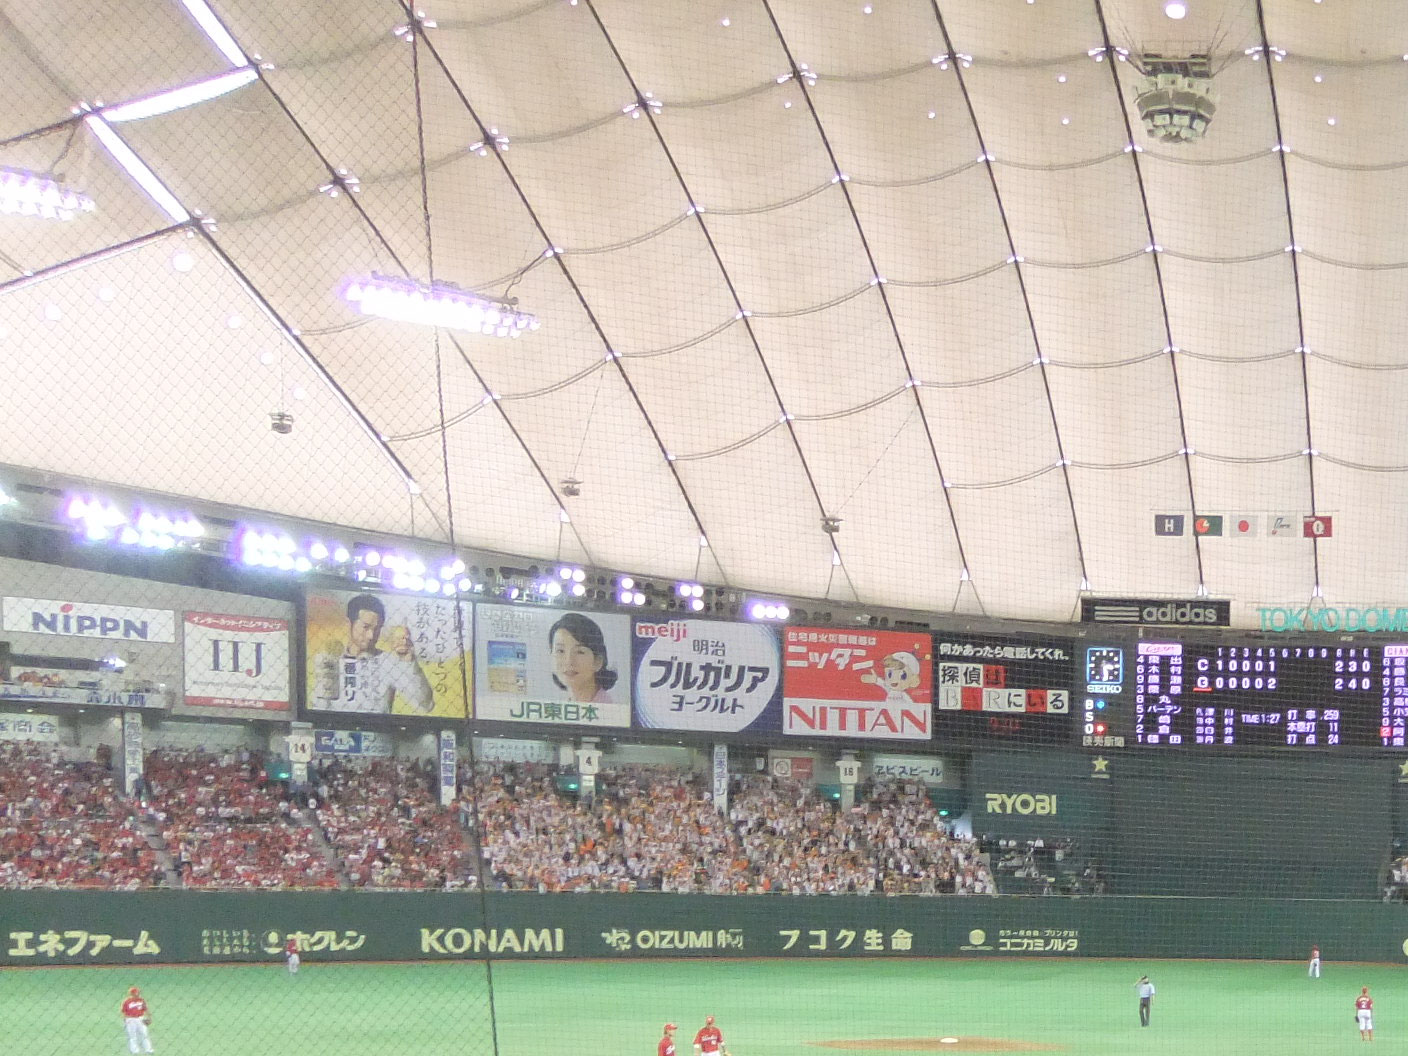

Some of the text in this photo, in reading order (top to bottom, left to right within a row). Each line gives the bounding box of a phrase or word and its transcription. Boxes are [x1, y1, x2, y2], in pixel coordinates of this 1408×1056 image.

[32, 603, 149, 640] NIPPN
[1143, 604, 1217, 622] adidas
[1258, 608, 1341, 632] TOKYO
[636, 621, 687, 641] meiji
[693, 640, 726, 657] 明治
[786, 645, 874, 671] ニッタン
[1218, 648, 1222, 657] 1
[1230, 648, 1236, 657] 2
[1243, 648, 1249, 657] 3
[1256, 648, 1262, 657] 4
[209, 639, 266, 678] IIJ
[1197, 659, 1370, 671] C 1 0 0 0 1 2 3 0
[649, 658, 770, 694] ブルガリア
[1197, 676, 1370, 689] G 0 0 0 0 2 2 4 0
[1087, 685, 1122, 693] SEIKO
[510, 701, 599, 722] JR東日本
[670, 695, 745, 714] ヨーグルト
[1085, 699, 1094, 710] B
[789, 704, 928, 734] NITTAN
[1085, 711, 1094, 722] S
[1241, 713, 1280, 723] TIME 1:27
[1329, 722, 1338, 732] 11
[1328, 734, 1339, 744] 24
[585, 756, 592, 766] 4
[985, 794, 1057, 815] RYOBI
[8, 930, 161, 957] エネファーム
[286, 930, 367, 952] ホクレン
[420, 927, 565, 954] KONAMI
[636, 930, 713, 949] OIZUMI
[779, 928, 914, 951] フコク生命
[999, 938, 1079, 951] コニカミノルタ
